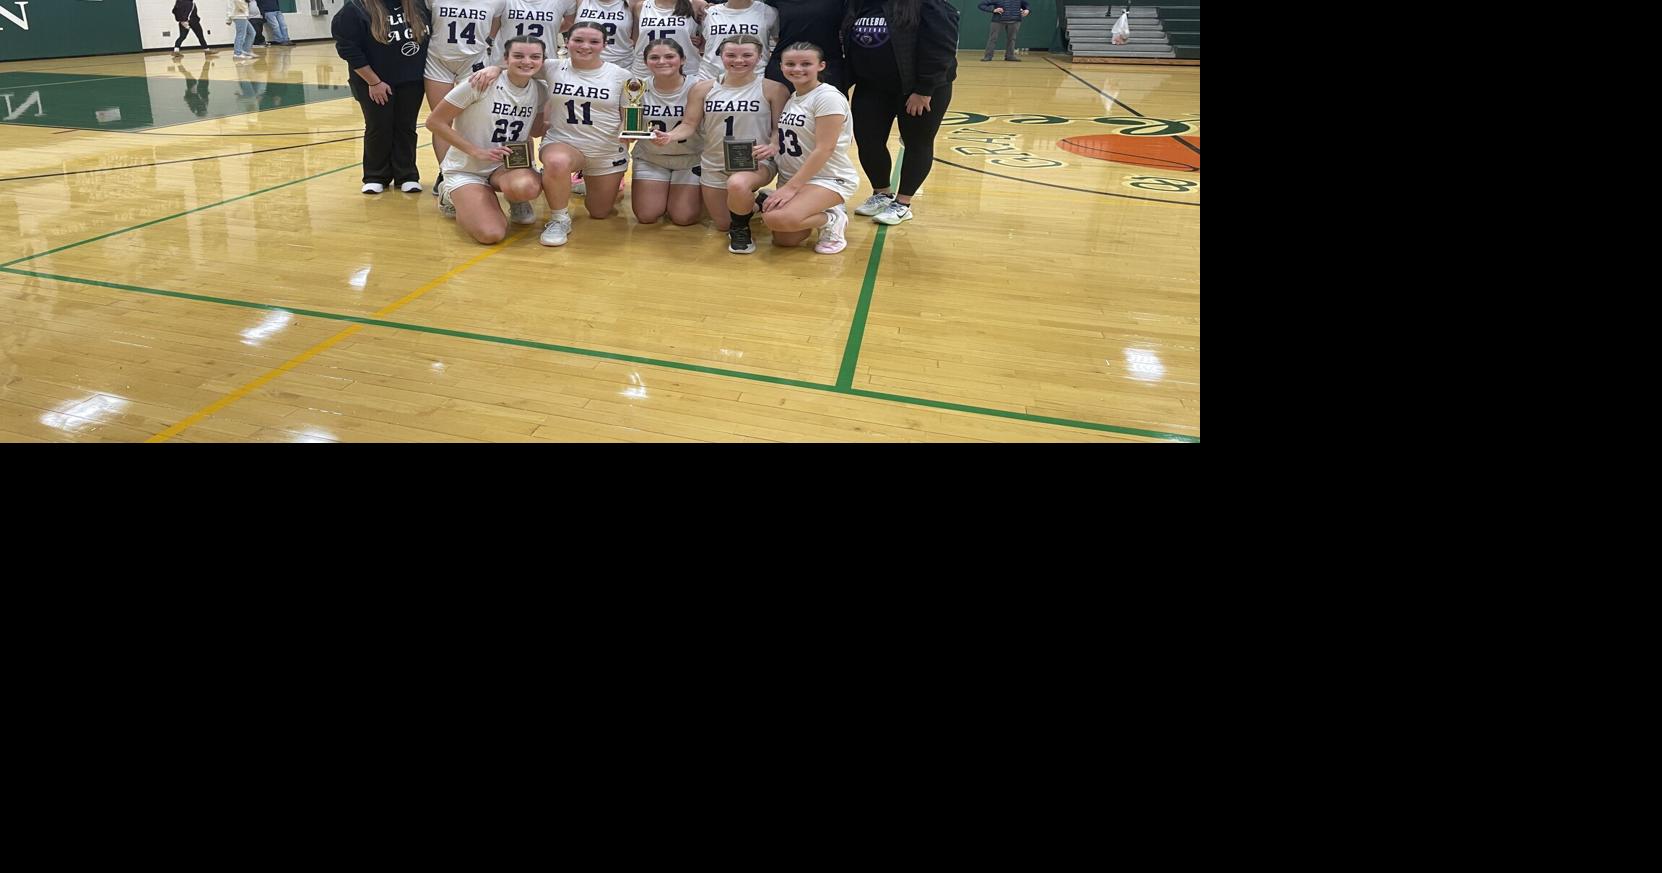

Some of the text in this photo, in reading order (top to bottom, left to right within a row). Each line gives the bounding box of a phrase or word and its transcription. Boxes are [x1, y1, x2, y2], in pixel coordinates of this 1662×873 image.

[439, 7, 487, 20] BEARS
[508, 9, 554, 21] BEARS
[580, 8, 625, 20] BEARS
[641, 17, 686, 27] BEARS
[447, 20, 476, 44] 14
[710, 24, 759, 35] BEARS
[387, 30, 402, 43] A
[552, 82, 610, 100] BEARS
[492, 102, 533, 118] BEARS
[564, 99, 594, 126] 11
[642, 104, 684, 117] BEAR
[705, 100, 760, 112] BEARS
[779, 111, 807, 127] EARS
[491, 118, 524, 143] 23
[724, 115, 735, 137] 1
